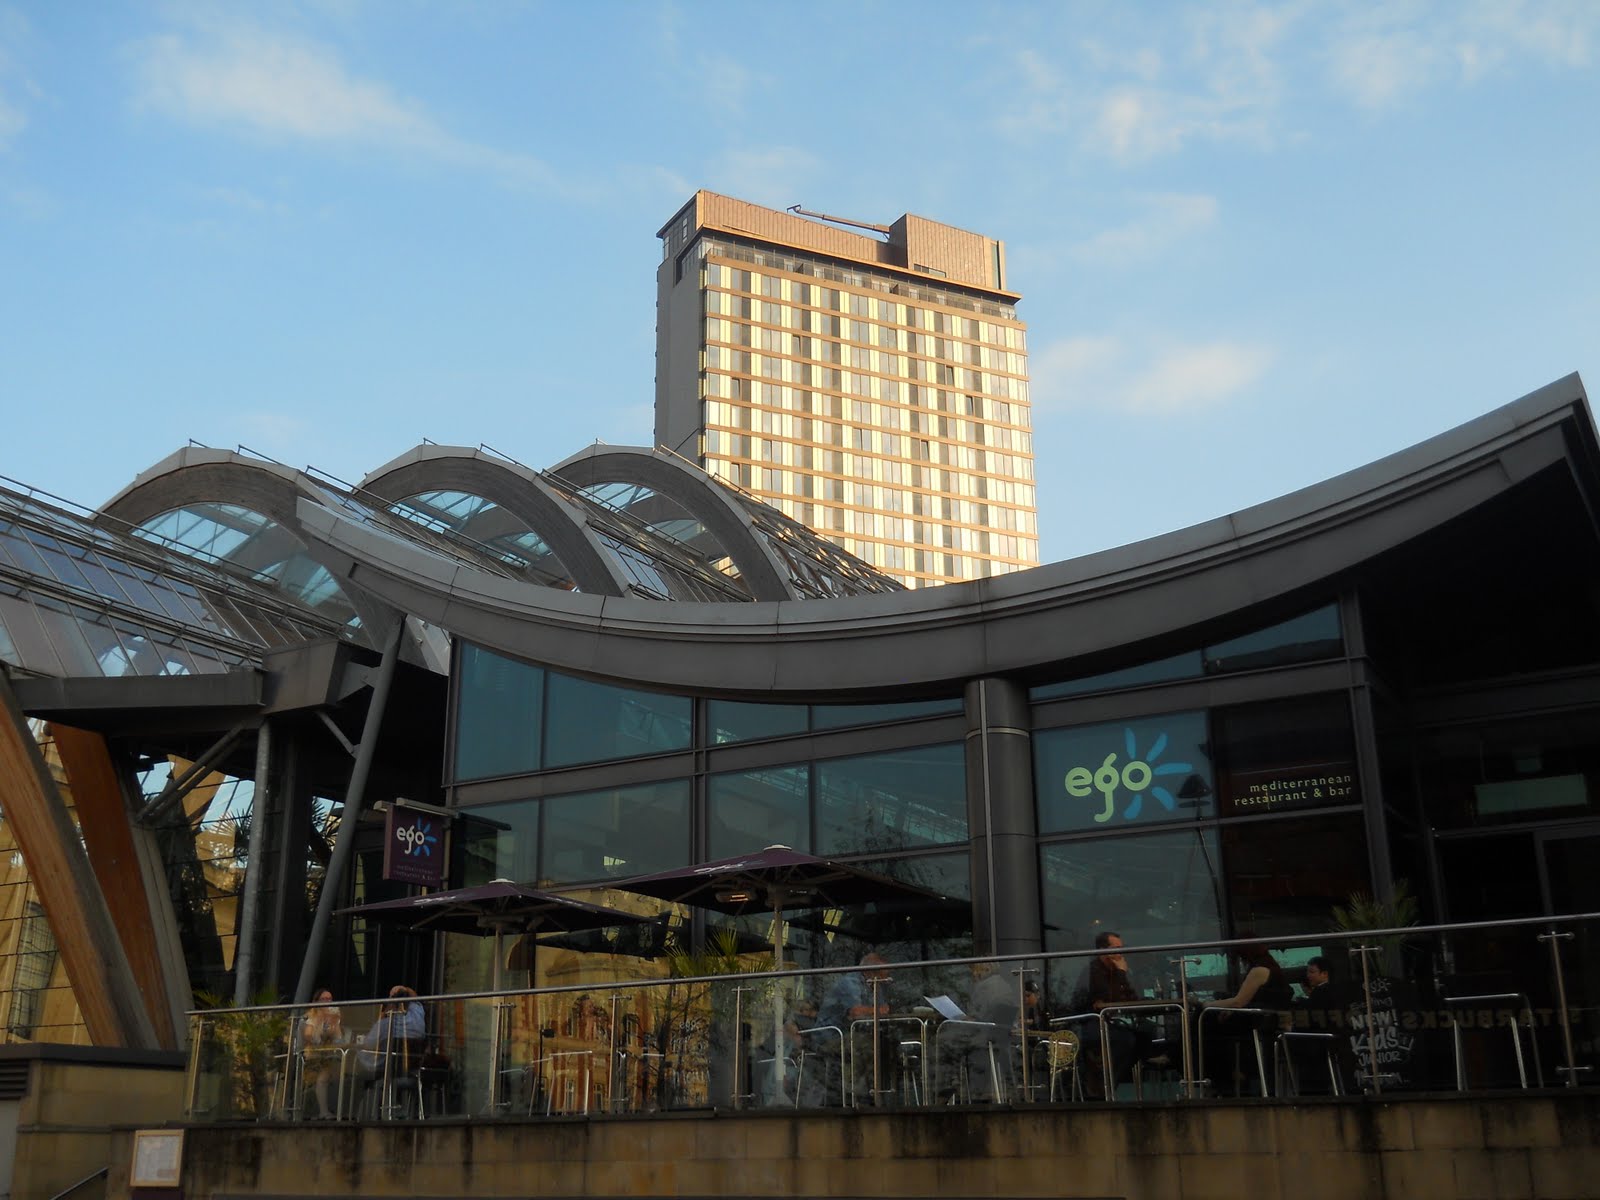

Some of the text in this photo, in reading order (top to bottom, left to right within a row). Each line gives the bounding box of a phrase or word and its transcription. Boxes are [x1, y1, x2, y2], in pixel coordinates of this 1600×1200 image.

[1064, 752, 1152, 822] ego
[1234, 786, 1352, 806] restaurant & bar
[1249, 775, 1352, 793] mediterranean
[396, 825, 425, 854] ego
